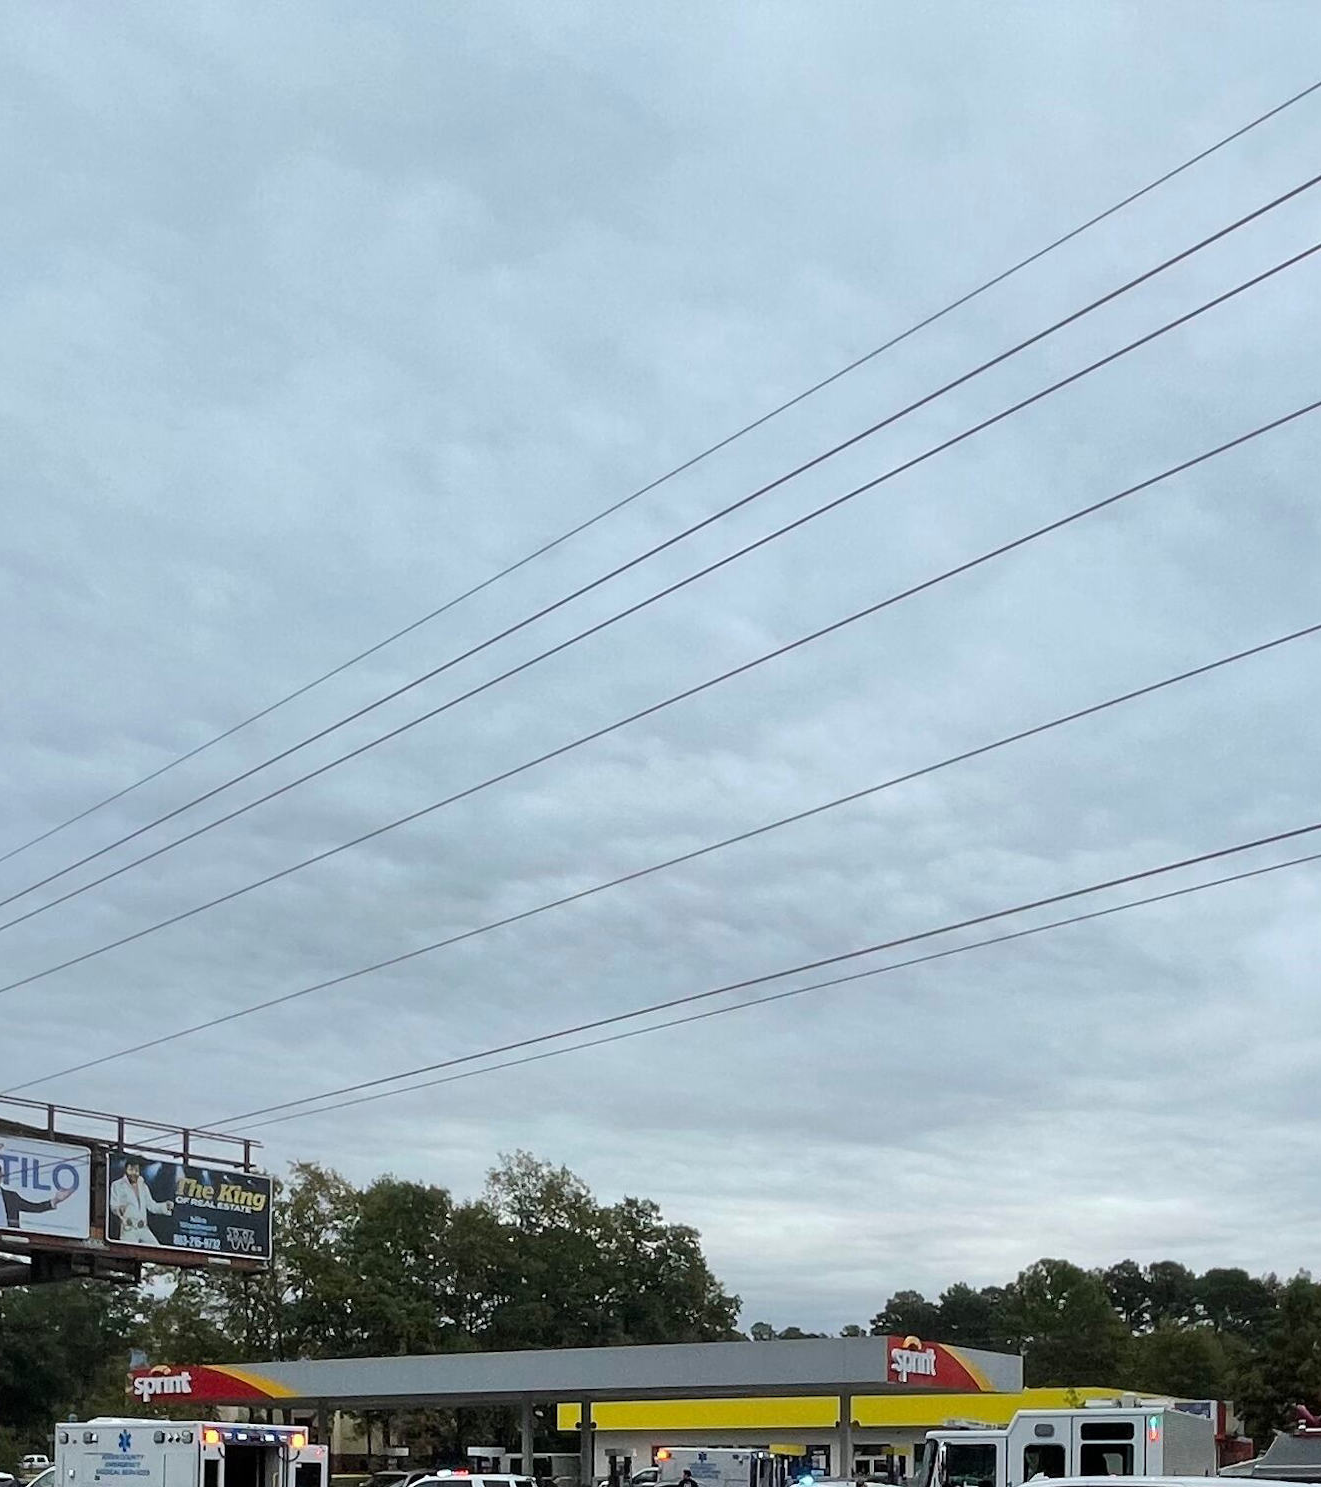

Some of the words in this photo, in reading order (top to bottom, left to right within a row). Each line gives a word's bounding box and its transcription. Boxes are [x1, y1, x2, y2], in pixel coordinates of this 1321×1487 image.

[175, 1196, 190, 1205] OF
[191, 1198, 216, 1209] REAL
[216, 1200, 252, 1214] ESTATE
[176, 1177, 216, 1200] The
[216, 1183, 267, 1212] King
[890, 1347, 937, 1383] sprint
[133, 1371, 192, 1403] sprint
